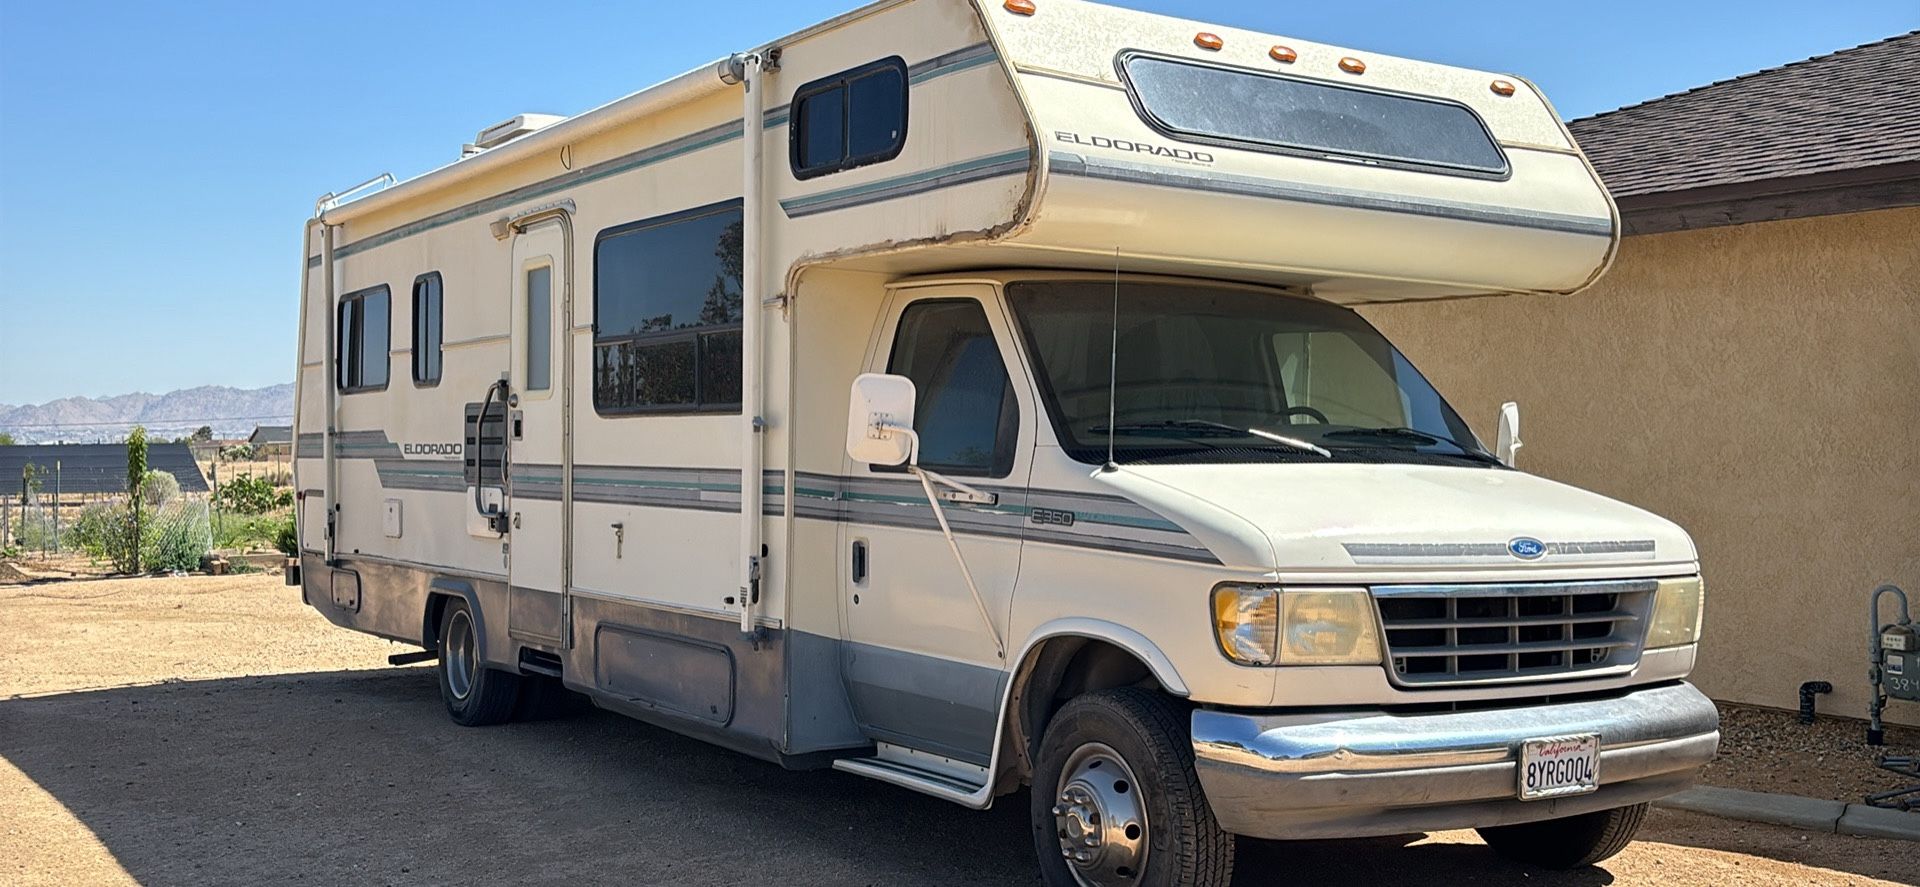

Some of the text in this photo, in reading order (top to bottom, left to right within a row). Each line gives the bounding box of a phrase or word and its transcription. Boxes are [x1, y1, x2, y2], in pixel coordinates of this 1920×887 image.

[1054, 130, 1214, 163] ELDORADO
[403, 442, 462, 455] ELDORADO
[1031, 507, 1074, 526] E350
[1518, 541, 1538, 553] Ford
[1539, 742, 1585, 759] California
[1527, 755, 1593, 788] 8YRG004
